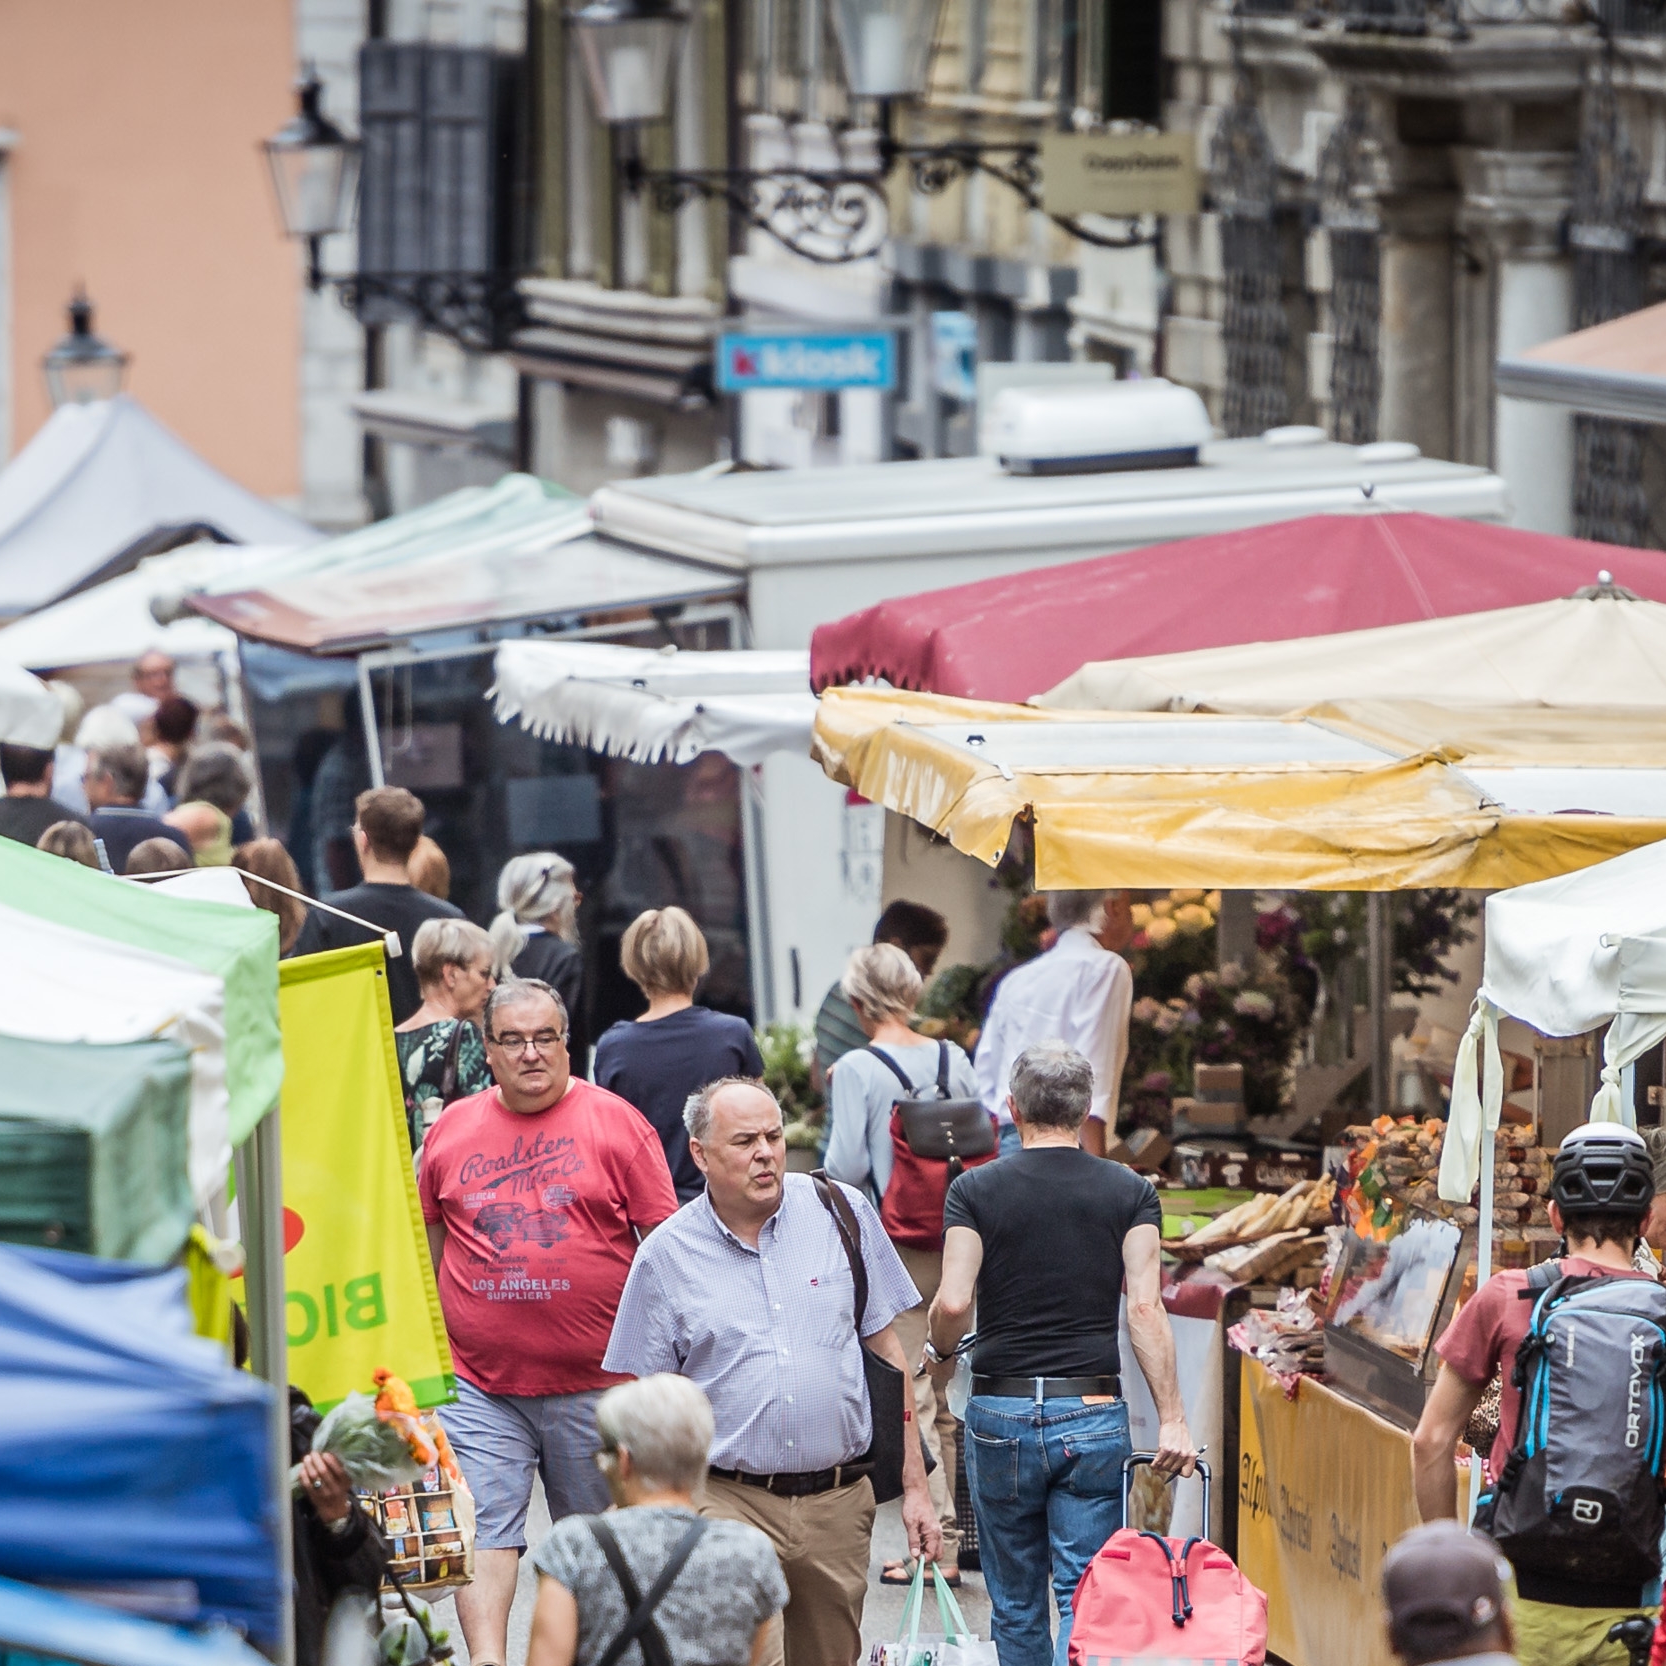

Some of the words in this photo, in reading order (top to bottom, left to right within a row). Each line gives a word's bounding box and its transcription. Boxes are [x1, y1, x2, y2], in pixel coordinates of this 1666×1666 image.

[460, 1131, 575, 1186] Roadster
[472, 1279, 495, 1291] LOS
[499, 1279, 571, 1291] ANGELES
[486, 1291, 552, 1300] SUPPLIERS
[1625, 1332, 1646, 1449] ORTOVOX
